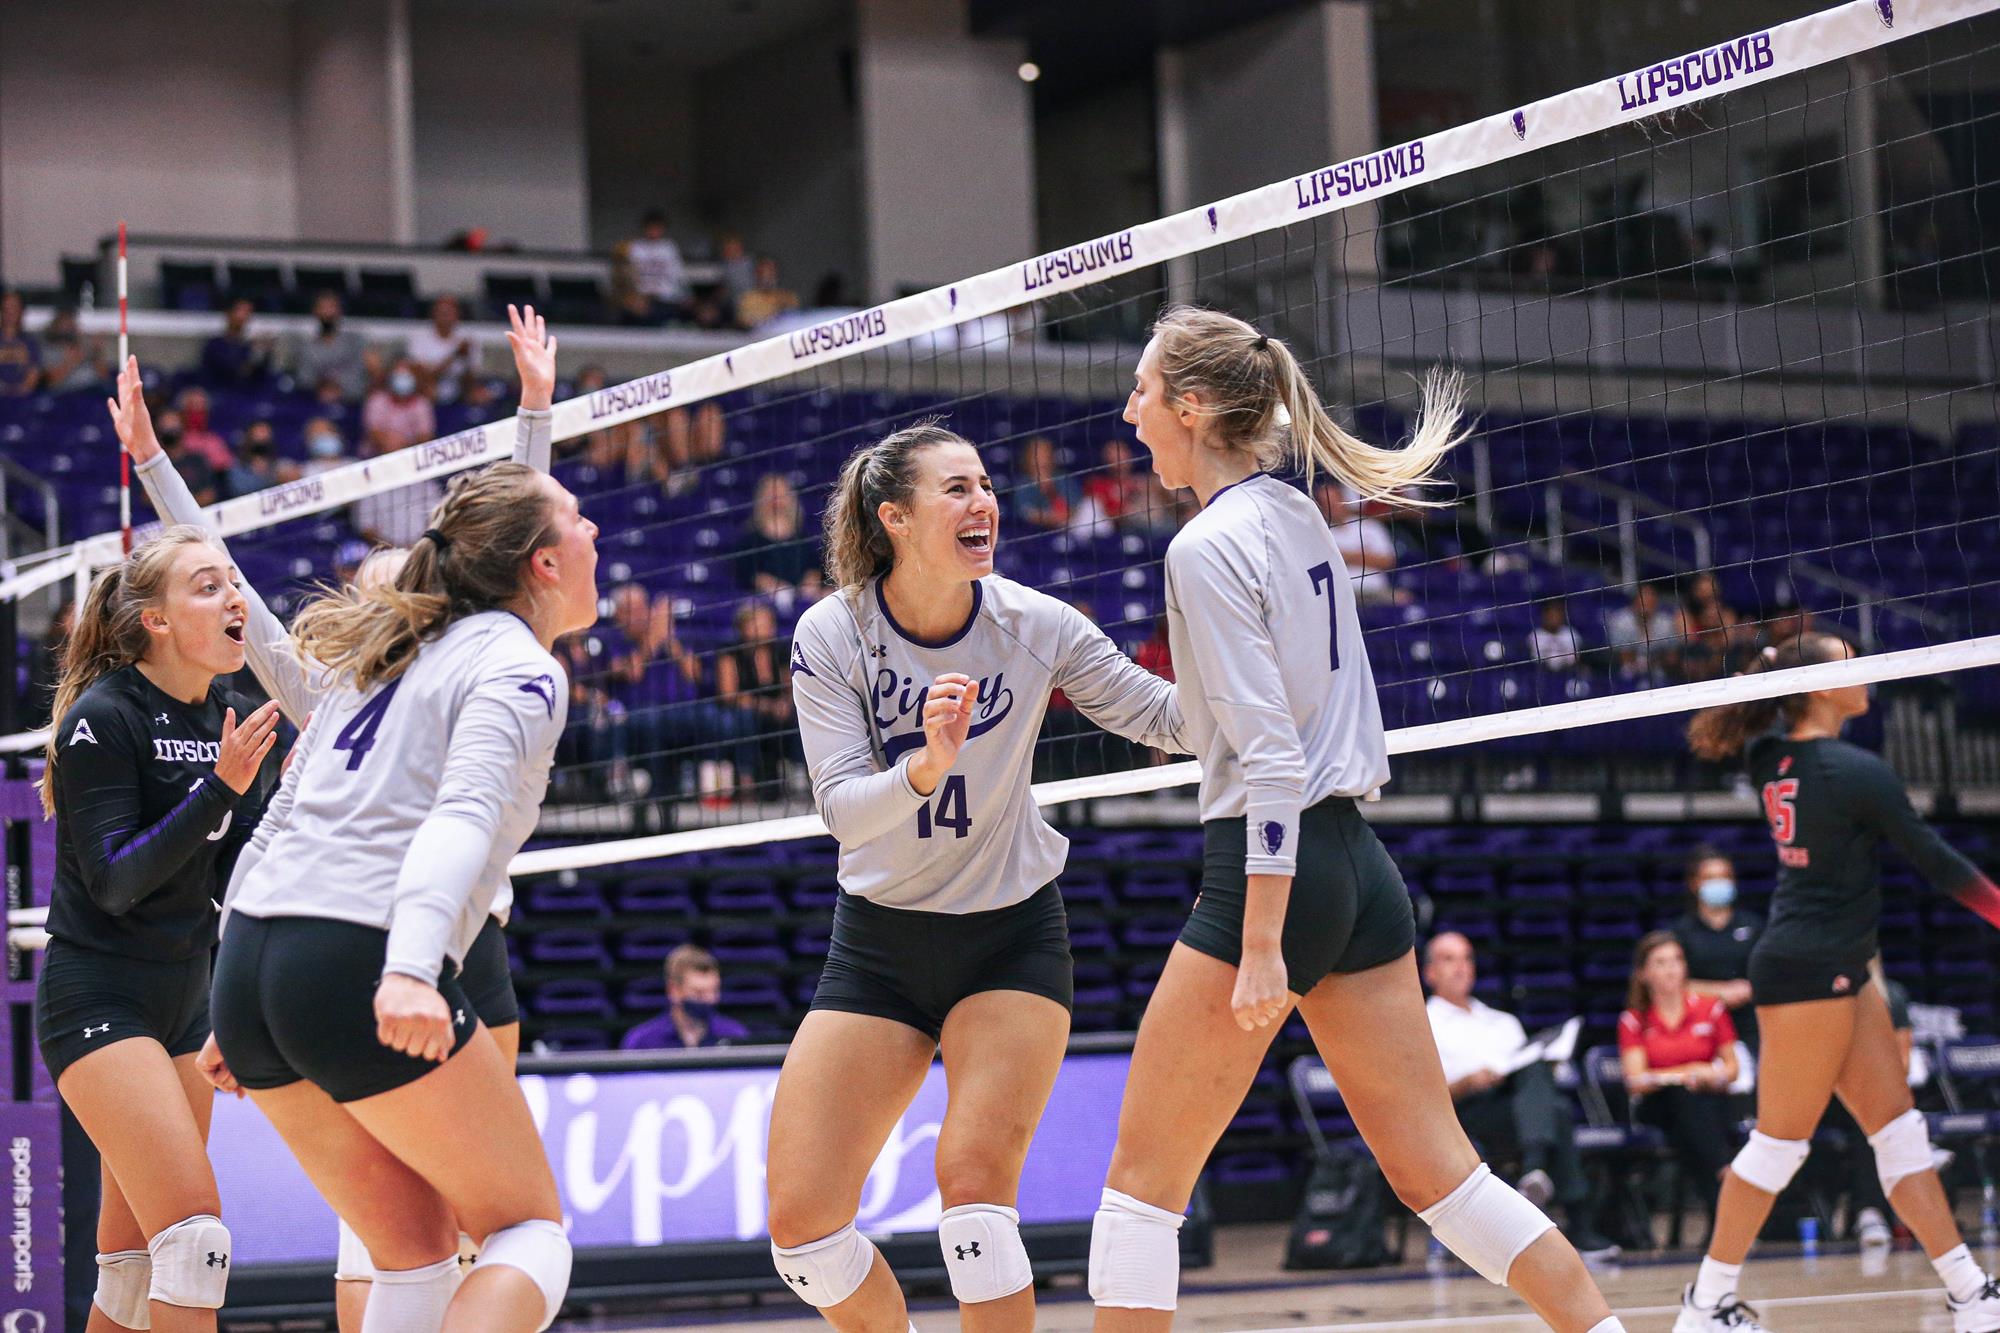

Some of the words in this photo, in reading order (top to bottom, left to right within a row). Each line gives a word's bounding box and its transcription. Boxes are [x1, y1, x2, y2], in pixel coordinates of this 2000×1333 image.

[1617, 32, 1774, 112] LIPSCOMB
[1296, 141, 1425, 209] LIPSCOMB
[1024, 232, 1133, 291] LIPSCOMB
[790, 309, 886, 359] LIPSCOMB
[591, 373, 672, 420] LIPSCOMB
[1307, 561, 1340, 672] 7
[333, 673, 404, 771] 4
[872, 668, 1014, 728] Liy
[153, 739, 222, 762] LIPSCO
[917, 774, 972, 839] 14
